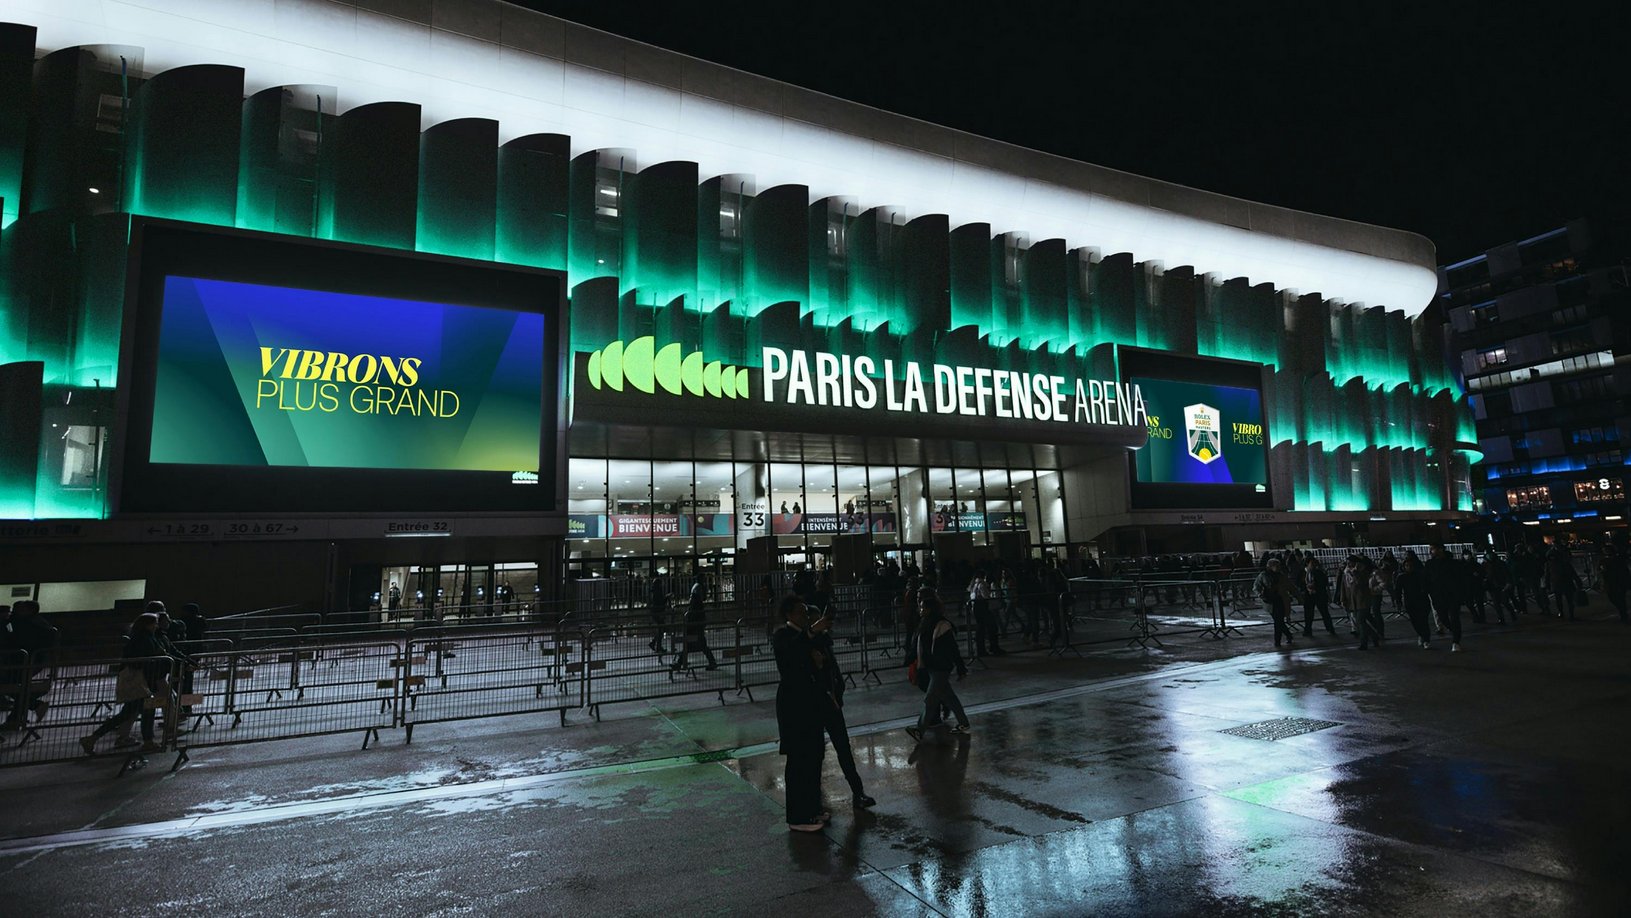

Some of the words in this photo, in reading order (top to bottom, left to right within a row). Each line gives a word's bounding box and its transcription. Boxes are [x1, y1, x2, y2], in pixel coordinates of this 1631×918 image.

[259, 346, 422, 387] VIBRONS
[762, 346, 878, 410] PARIS
[884, 359, 929, 413] LA
[933, 363, 1069, 422] DEFENSE
[1074, 378, 1149, 427] ARENA
[256, 379, 340, 413] PLUS
[349, 385, 460, 418] GRAND
[1146, 426, 1173, 440] RAND
[1232, 422, 1263, 436] VIBRO
[1233, 433, 1255, 445] PLUS
[388, 520, 429, 531] Entrée
[432, 521, 448, 531] 32
[743, 512, 764, 527] 33
[947, 520, 985, 528] INVENU
[166, 524, 172, 534] 1
[176, 523, 185, 534] à
[190, 524, 209, 534] 29
[229, 523, 248, 533] 30
[252, 522, 261, 533] à
[265, 523, 283, 533] 67
